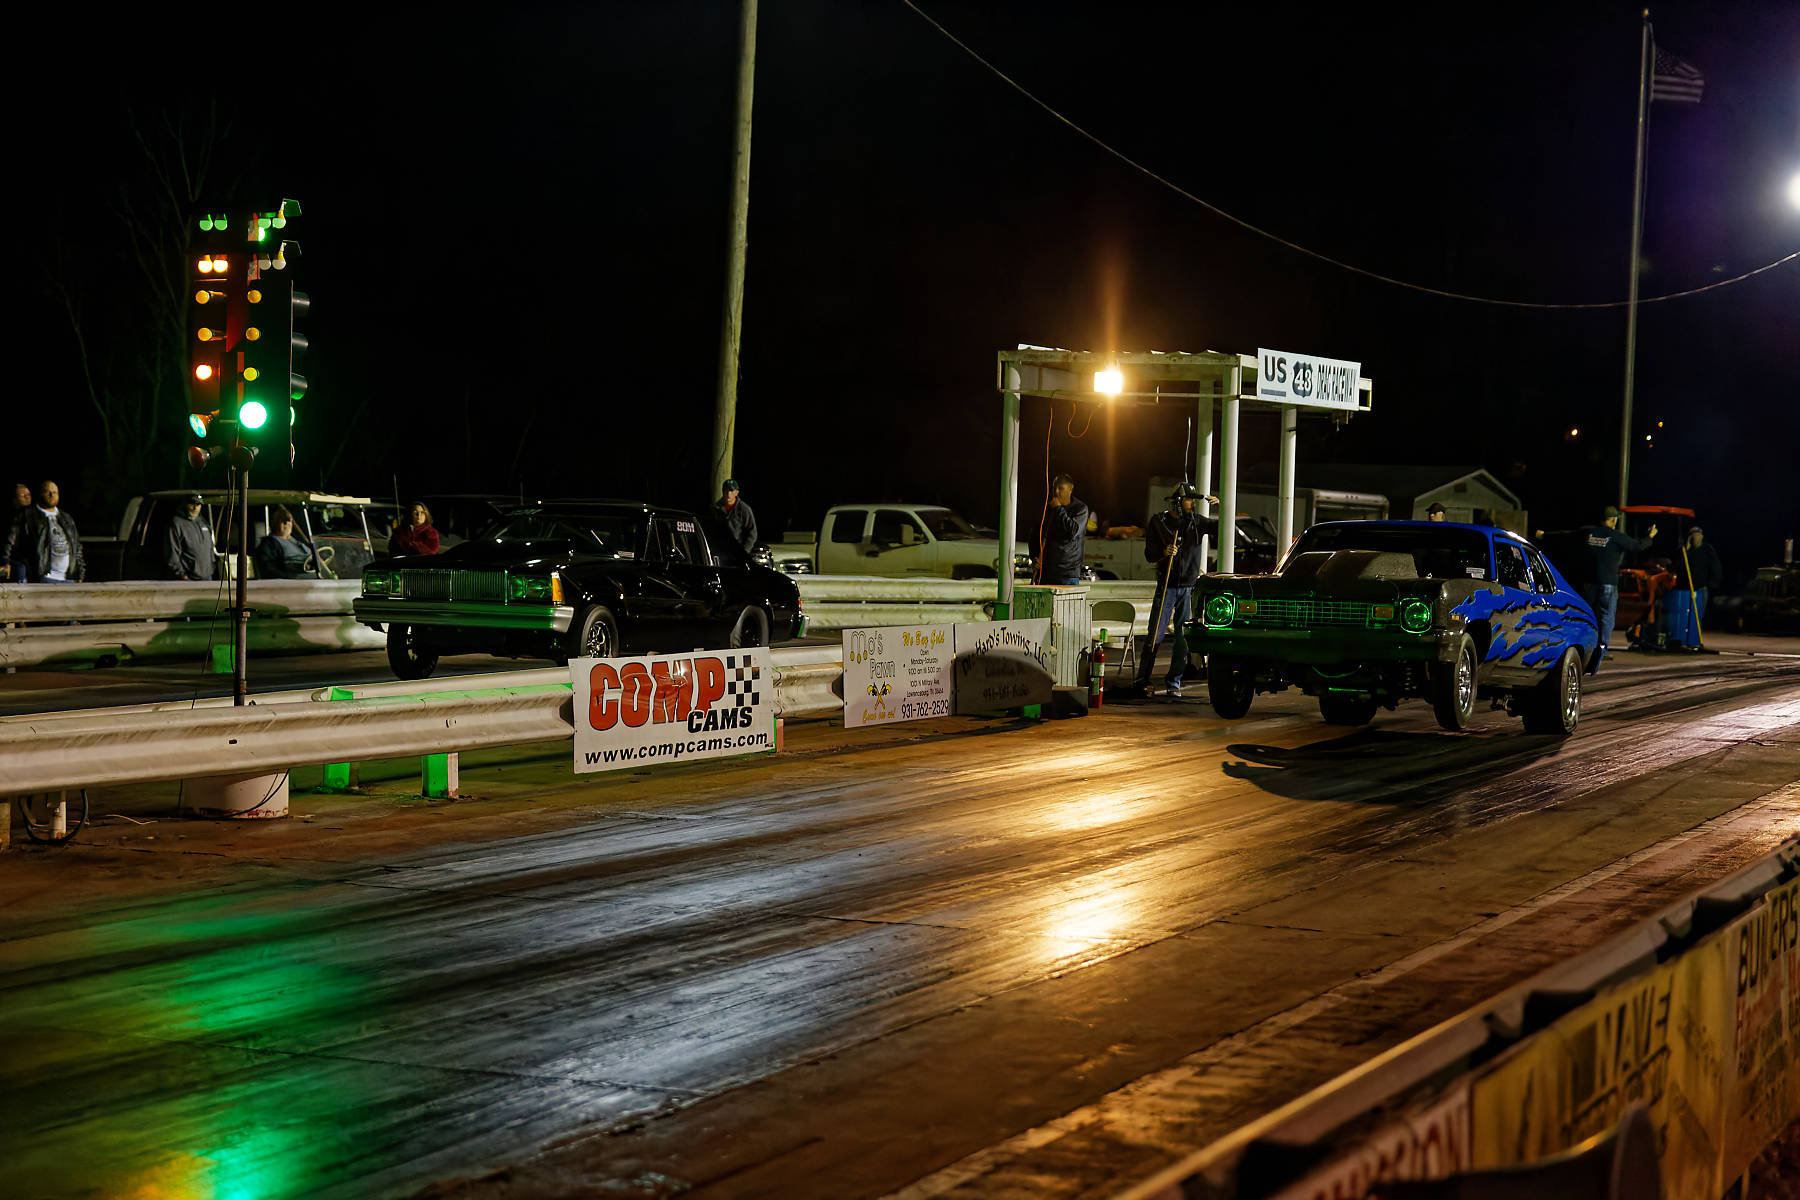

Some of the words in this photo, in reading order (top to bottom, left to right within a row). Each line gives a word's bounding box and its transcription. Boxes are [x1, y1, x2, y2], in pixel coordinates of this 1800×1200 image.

[1265, 355, 1286, 383] US
[1294, 368, 1312, 391] 43
[915, 630, 929, 649] Buy
[930, 628, 945, 649] Gold
[869, 658, 896, 680] Pawn
[1033, 641, 1048, 672] LLC
[589, 657, 725, 731] COMP
[687, 706, 753, 734] CAMS
[901, 699, 949, 719] 931-762-2529
[585, 732, 768, 765] www.compcams.com
